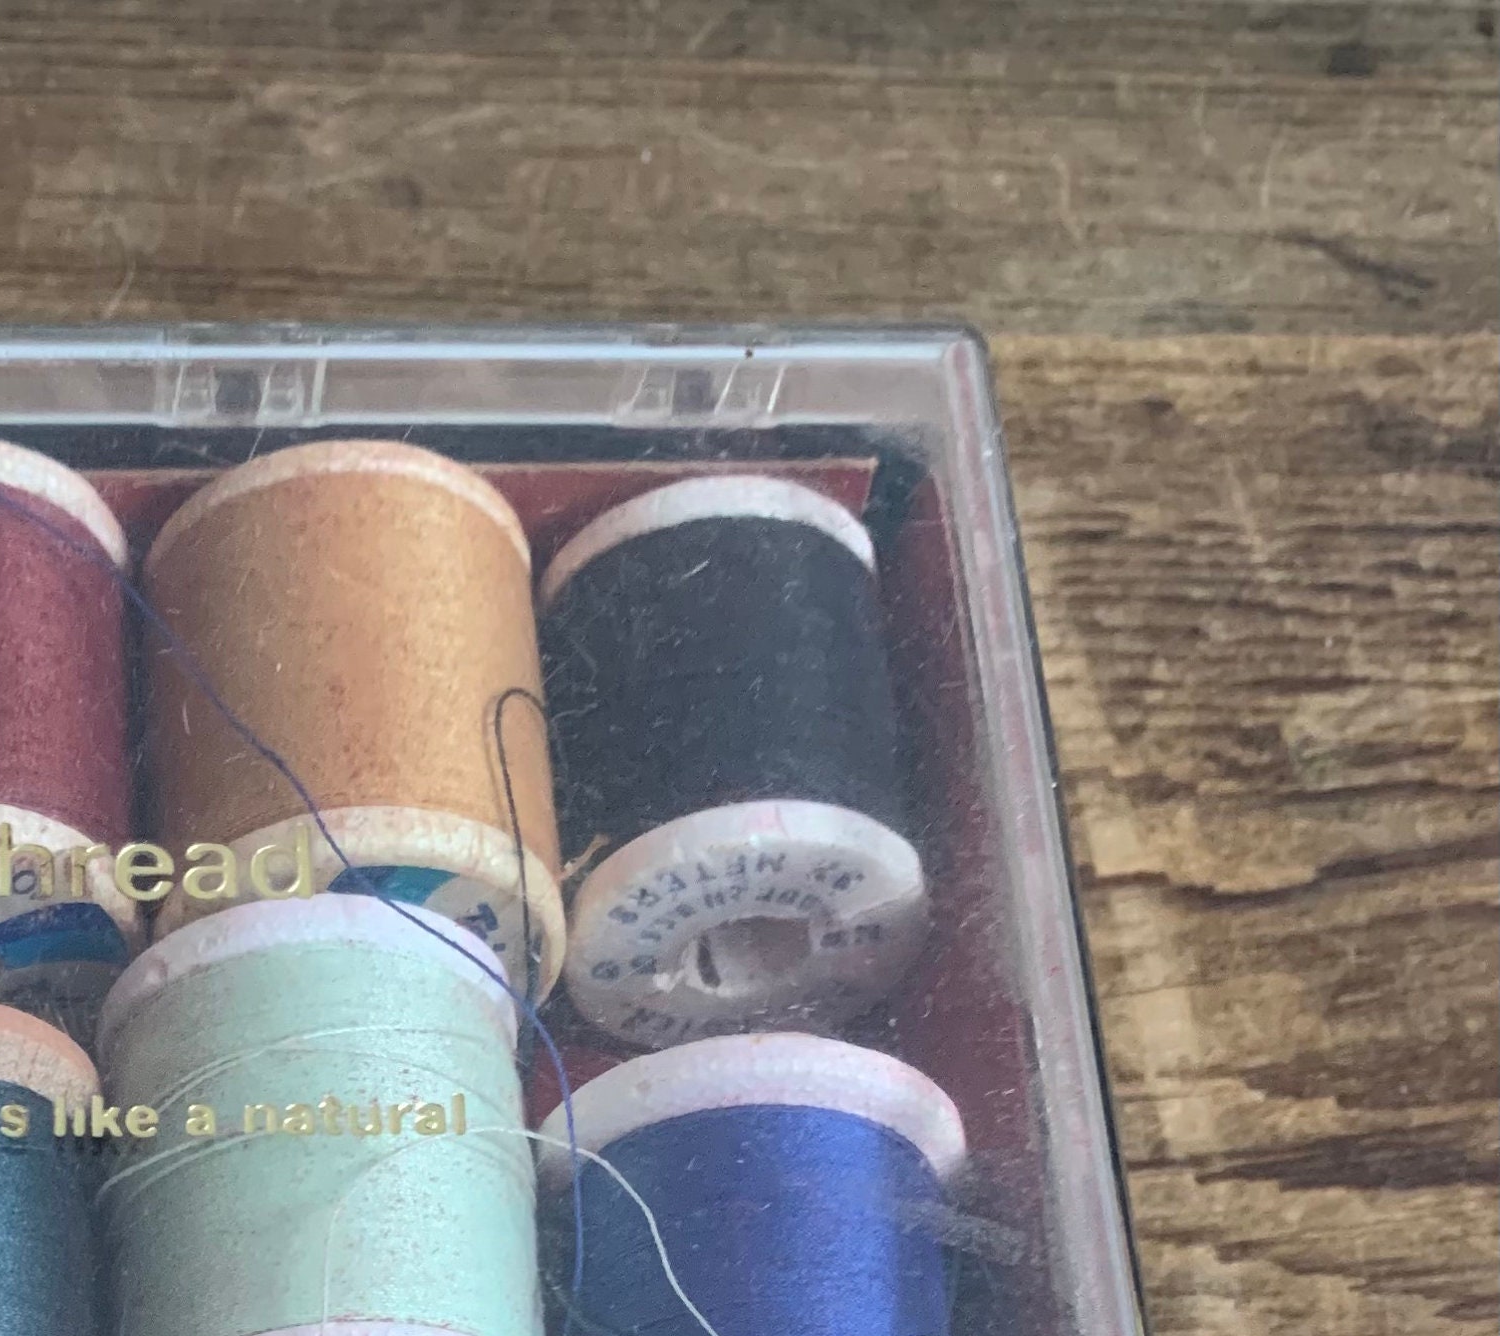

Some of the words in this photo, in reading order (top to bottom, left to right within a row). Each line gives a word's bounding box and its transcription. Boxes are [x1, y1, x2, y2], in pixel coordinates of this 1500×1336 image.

[54, 1097, 161, 1139] like
[185, 1104, 218, 1137] a
[241, 1093, 466, 1139] natural
